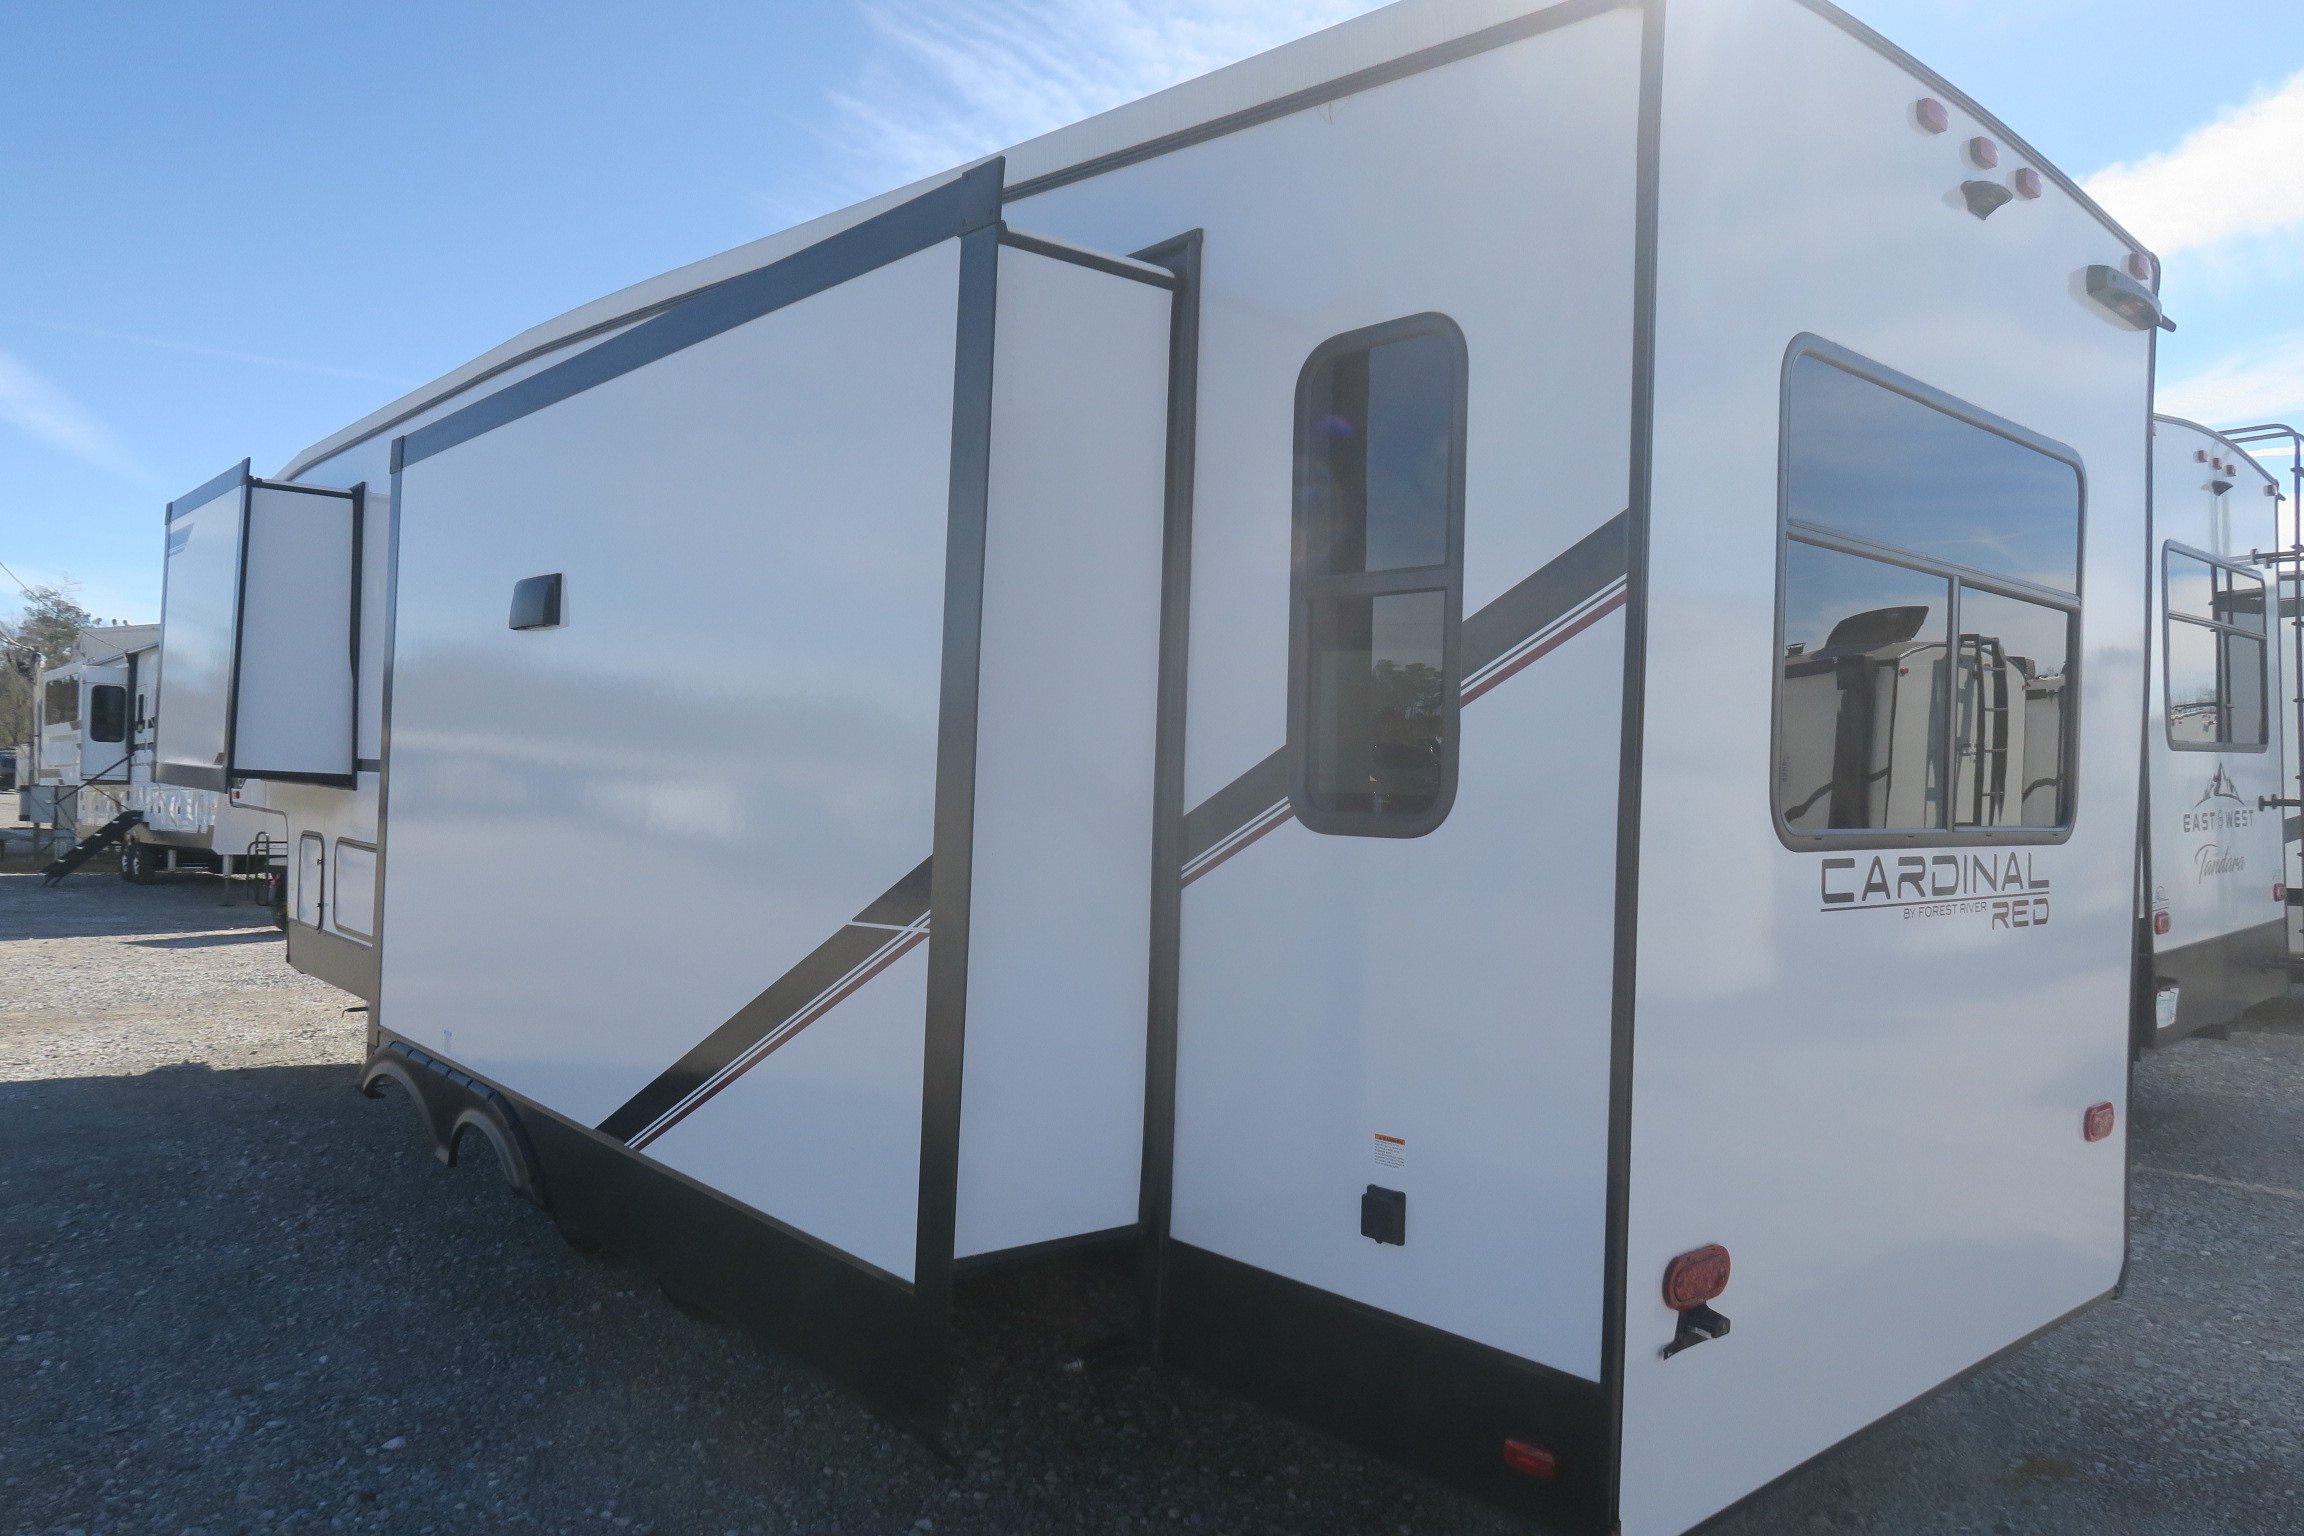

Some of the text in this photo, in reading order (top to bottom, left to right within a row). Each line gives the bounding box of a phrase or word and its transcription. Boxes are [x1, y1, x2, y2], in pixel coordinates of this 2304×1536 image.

[2183, 812, 2216, 833] EAST
[2225, 809, 2254, 829] WEST
[1821, 851, 2049, 904] CARDINAL
[1903, 901, 1987, 920] BY FOREST RIVER
[1991, 897, 2050, 930] RED
